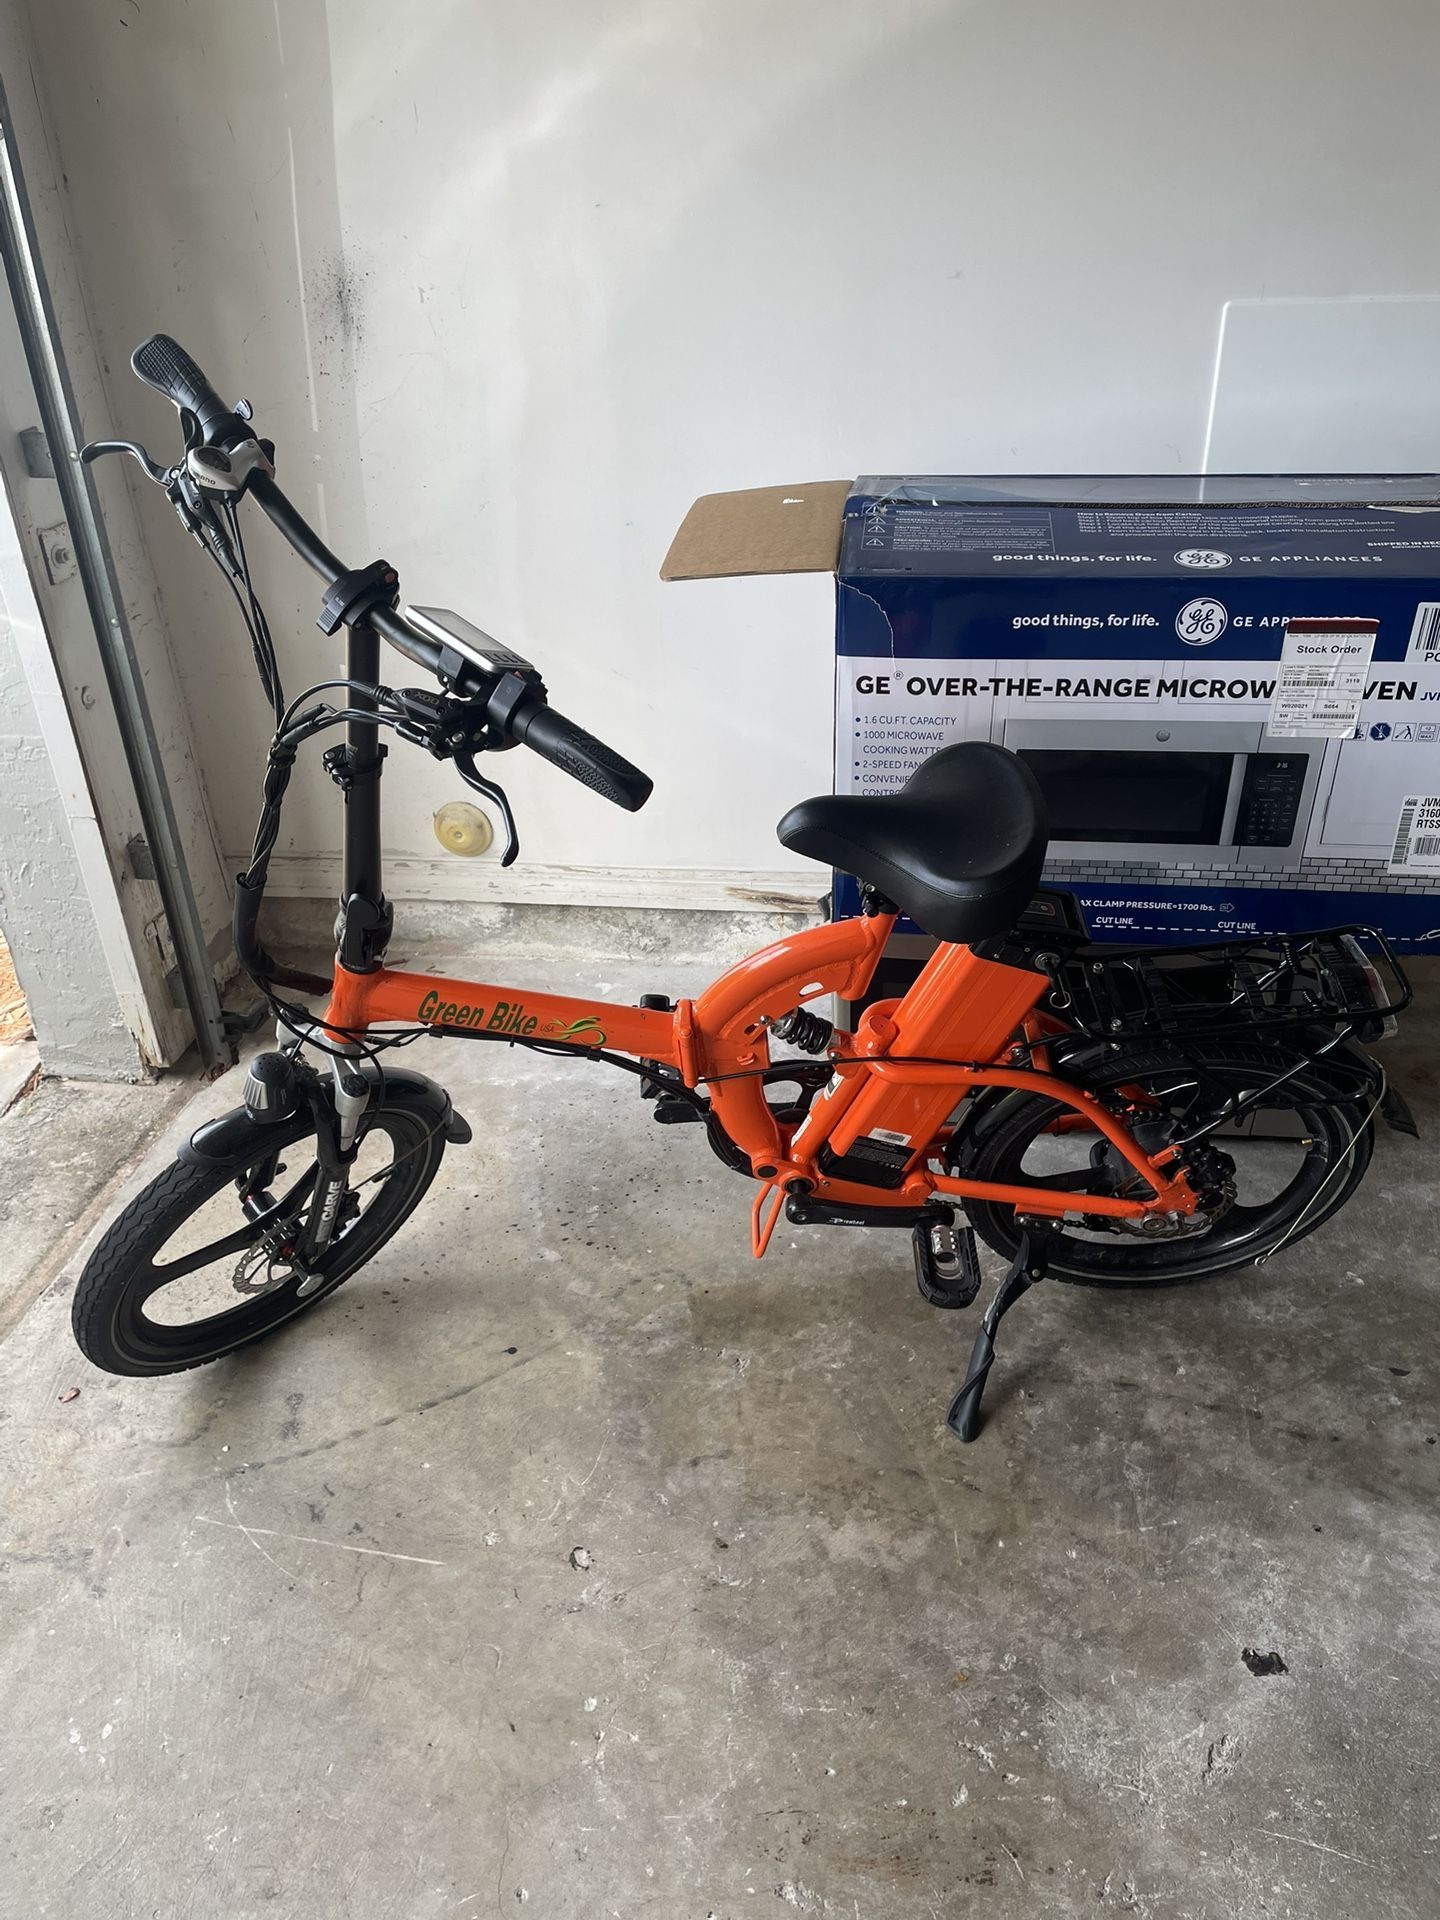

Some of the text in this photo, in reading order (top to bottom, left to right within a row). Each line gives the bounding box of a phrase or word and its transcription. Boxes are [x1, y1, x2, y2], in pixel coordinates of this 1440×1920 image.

[992, 554, 1034, 563] good
[1037, 554, 1095, 563] things,
[1125, 555, 1157, 563] life.
[1239, 555, 1384, 563] GE APPLIANCES
[1012, 613, 1160, 629] good things, for life.
[1232, 616, 1290, 628] GE APP
[1296, 645, 1363, 654] Stock Order
[906, 676, 1151, 698] OVER-THE-RANGE
[1156, 678, 1277, 699] MICROW
[1362, 680, 1418, 701] VEN
[864, 715, 877, 725] 1.6
[909, 716, 957, 726] CAPACITY
[864, 730, 944, 741] 1000 MICROWAVE
[862, 744, 908, 756] COOKING
[862, 759, 902, 769] 2-SPEED
[862, 774, 911, 785] CONVENIE
[862, 788, 902, 796] CONTR
[1080, 899, 1092, 907] AX
[1092, 899, 1126, 908] CLAMP
[1126, 901, 1199, 911] PRESSURE=1700
[1200, 903, 1216, 912] lbs.
[1095, 916, 1134, 925] CUT LINE
[1217, 921, 1257, 930] CUT LINE
[417, 990, 485, 1028] Green
[486, 1001, 539, 1036] Bike
[320, 1180, 343, 1222] CARVE
